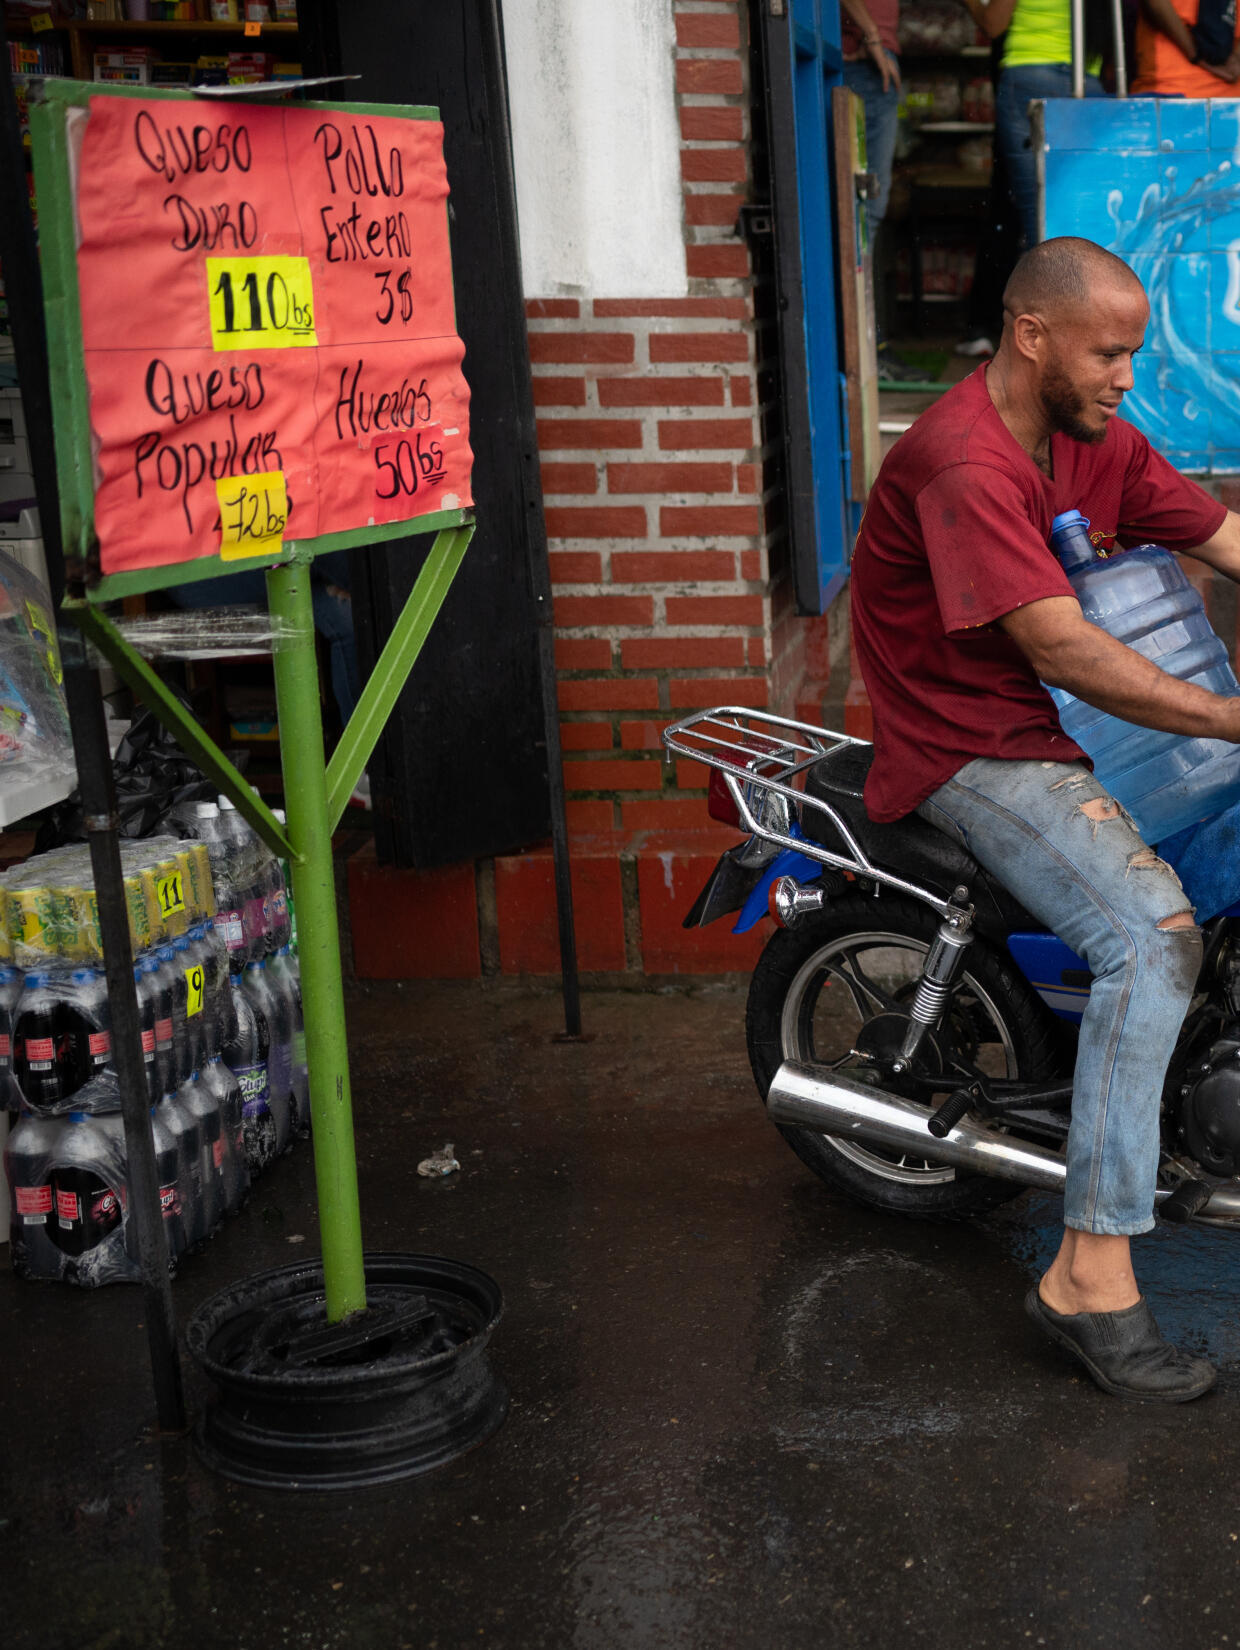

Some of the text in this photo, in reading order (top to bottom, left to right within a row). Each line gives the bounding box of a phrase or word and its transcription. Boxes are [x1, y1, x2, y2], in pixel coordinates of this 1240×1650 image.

[135, 110, 252, 183] Queso
[314, 123, 404, 197] Pollo
[375, 266, 413, 326] 3$
[145, 358, 265, 424] Queso
[335, 359, 432, 440] Huevos
[161, 877, 182, 912] 11
[192, 967, 201, 1009] 9
